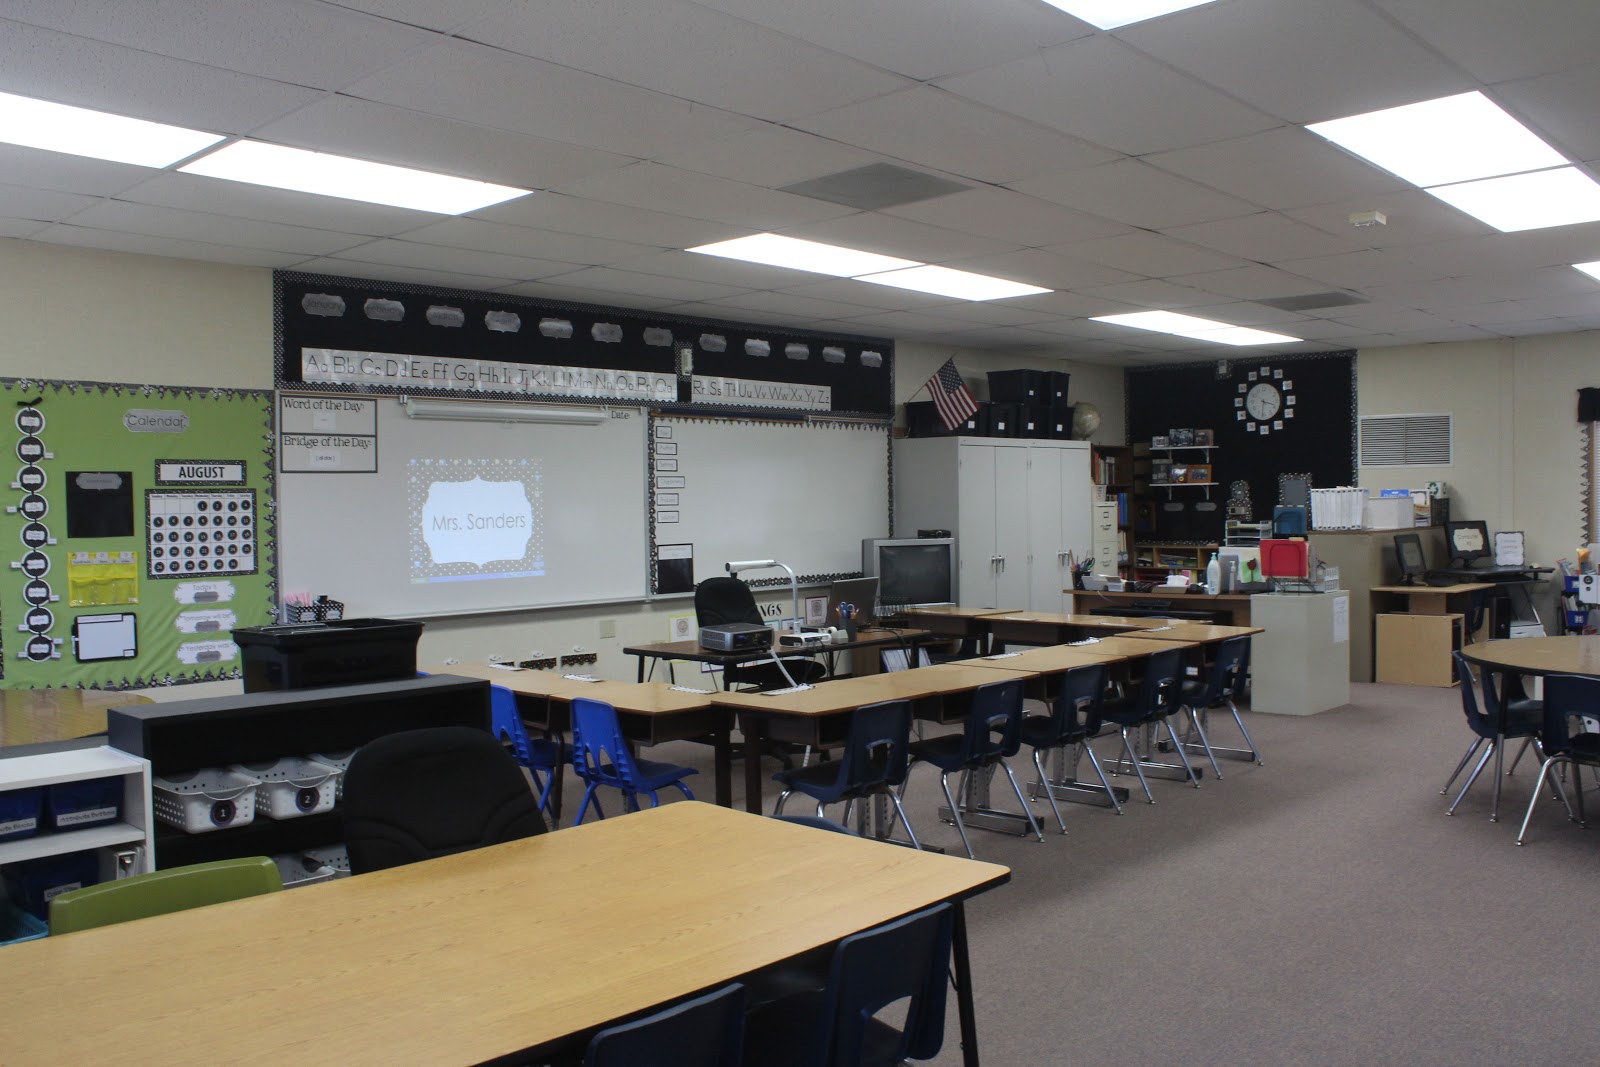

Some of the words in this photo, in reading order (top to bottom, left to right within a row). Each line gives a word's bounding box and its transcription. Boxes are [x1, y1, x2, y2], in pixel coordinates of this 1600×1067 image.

[306, 355, 328, 373] Aa
[333, 356, 355, 373] Bb
[360, 358, 381, 375] Cc
[386, 360, 407, 377] Dd
[411, 361, 429, 378] Ee
[433, 362, 449, 379] Ff
[454, 364, 475, 388] Gg
[479, 365, 499, 383] Hh
[503, 368, 512, 384] Ii
[515, 369, 528, 391] Jj
[596, 374, 613, 390] Nn
[616, 376, 634, 390] Oo
[638, 377, 652, 398] Pp
[656, 378, 675, 399] Qq
[693, 380, 706, 394] Rr
[710, 382, 722, 396] Ss
[725, 382, 736, 396] Tt
[738, 384, 752, 398] Uu
[754, 385, 766, 398] Vv
[769, 386, 788, 400] Ww
[791, 388, 803, 401] Xx
[804, 389, 816, 408] Yy
[818, 390, 830, 404] Zz
[283, 398, 311, 409] Word
[312, 400, 325, 410] of
[325, 400, 342, 410] the
[126, 414, 184, 428] Calendar
[284, 436, 319, 448] Bridge
[321, 436, 333, 446] of
[333, 437, 351, 447] the
[178, 466, 225, 478] AUGUST
[432, 514, 462, 531] Mrs.
[467, 512, 526, 530] Sanders
